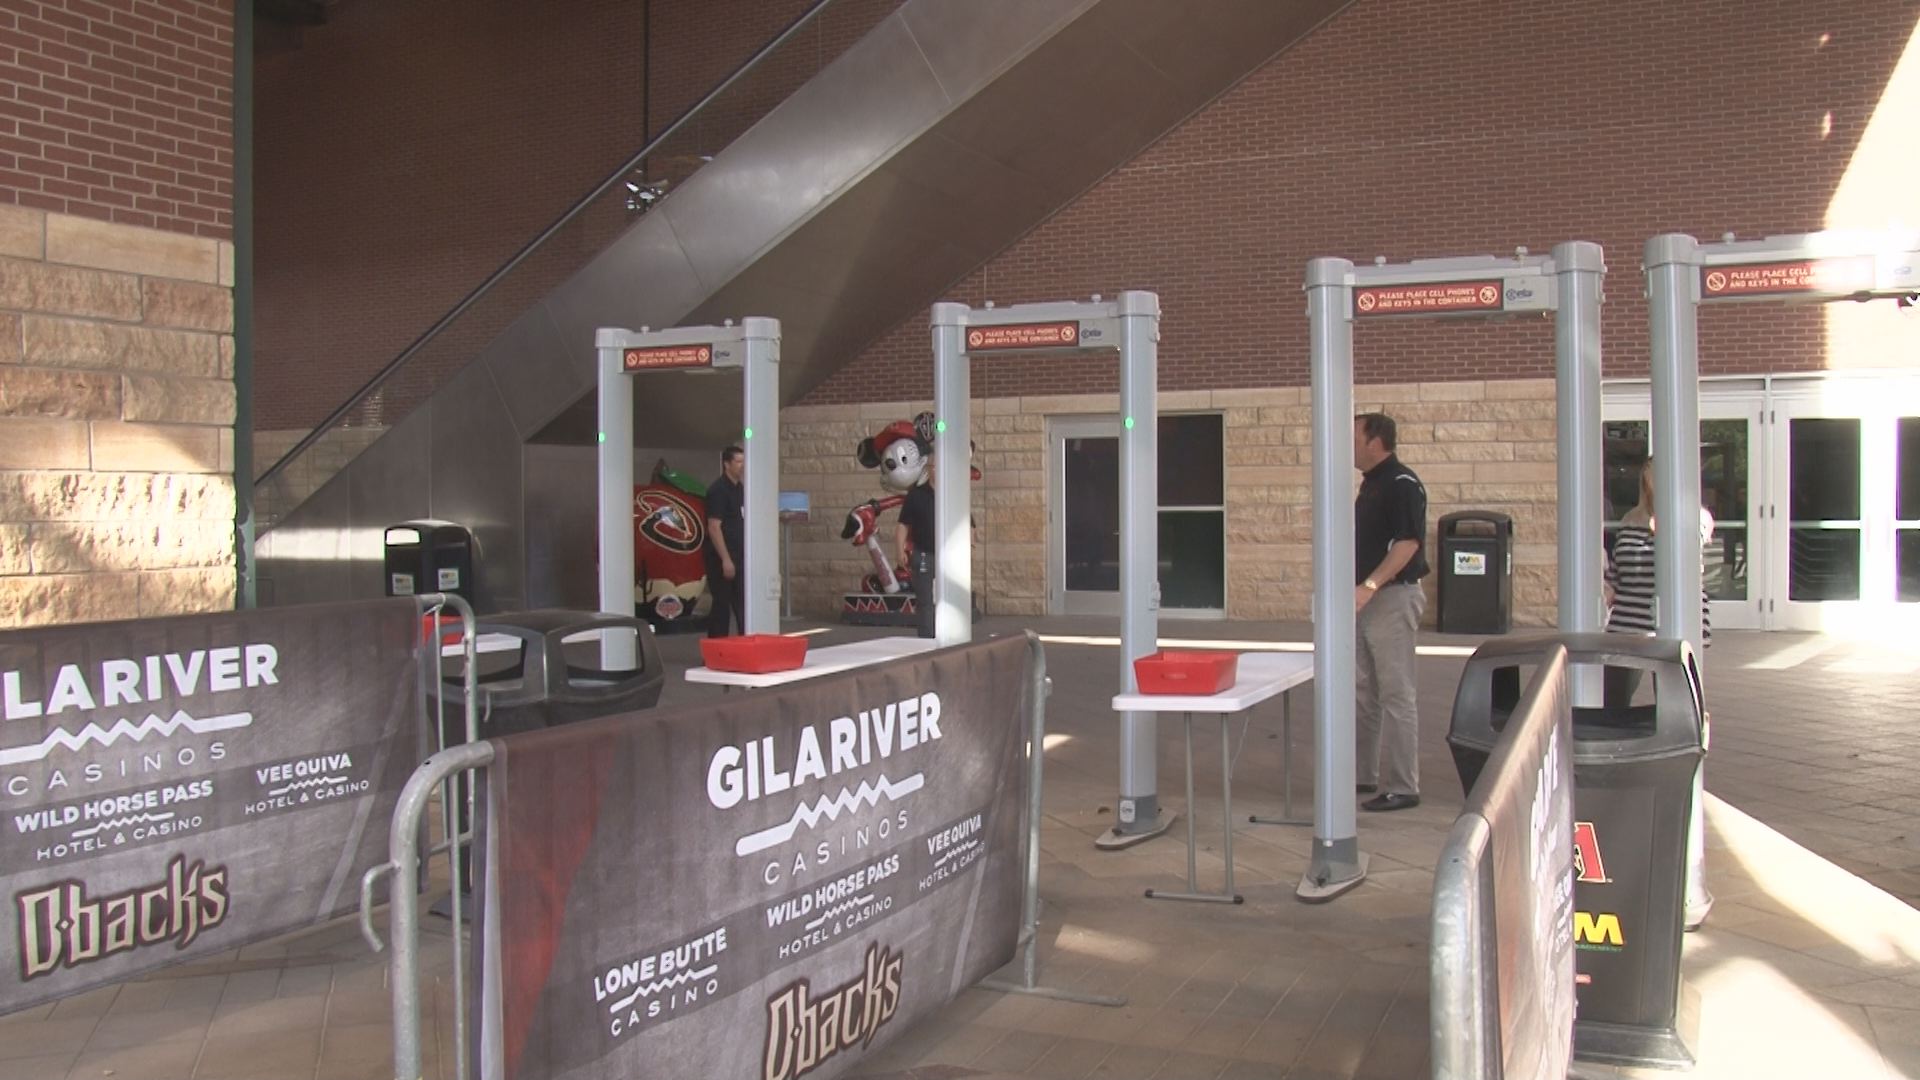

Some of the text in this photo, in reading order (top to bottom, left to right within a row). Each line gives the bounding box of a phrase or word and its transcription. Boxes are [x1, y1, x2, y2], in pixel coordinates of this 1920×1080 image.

[1378, 291, 1404, 299] PLEASE
[1406, 290, 1428, 298] PLACE
[1429, 289, 1445, 297] CELL
[1730, 279, 1746, 287] AND
[1748, 278, 1768, 287] KEYS
[1782, 277, 1797, 285] THE
[1731, 270, 1760, 279] PLEASE
[1762, 269, 1787, 278] PLACE
[1789, 267, 1808, 276] CELL
[8, 742, 226, 795] CASINOS
[15, 780, 214, 833] WILD HORSE PASS
[245, 796, 295, 815] HOTEL
[315, 780, 369, 799] CASINO
[37, 816, 203, 861] HOTEL & CASINO
[764, 810, 908, 885] CASINOS
[767, 854, 900, 928] WILD HORSE PASS
[919, 866, 949, 892] HOTEL
[779, 896, 892, 959] HOTEL & CASINO
[594, 927, 728, 1001] LONE BUTTE
[611, 978, 718, 1037] CASINO
